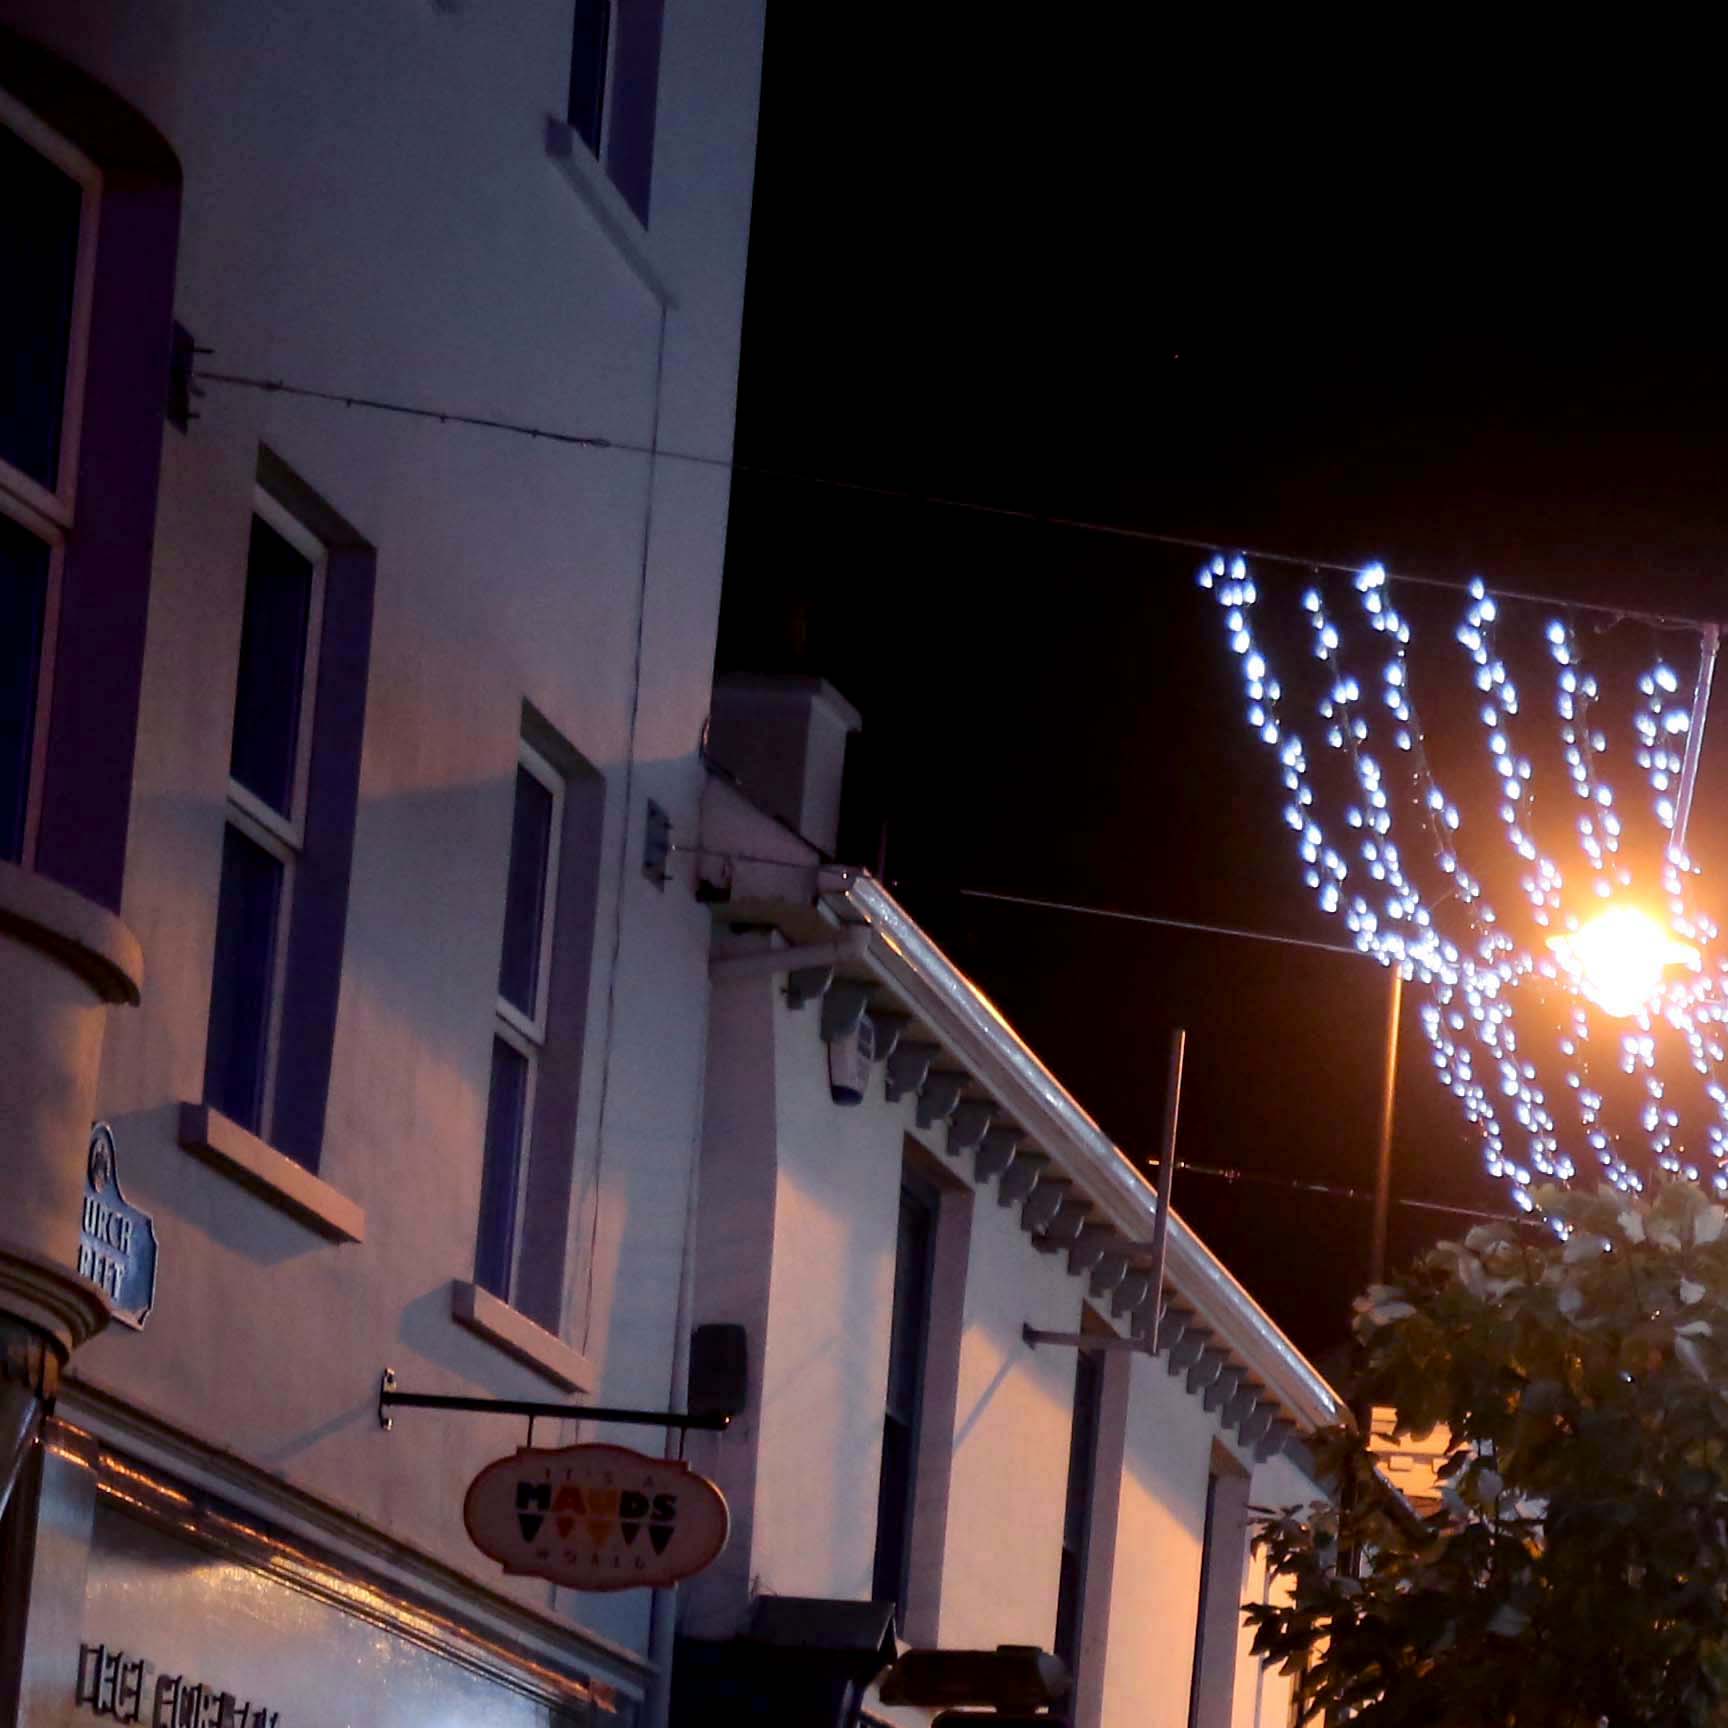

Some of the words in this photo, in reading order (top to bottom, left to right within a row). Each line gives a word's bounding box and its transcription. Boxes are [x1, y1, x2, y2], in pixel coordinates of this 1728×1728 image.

[82, 1196, 132, 1255] URCH
[77, 1243, 126, 1302] REET
[516, 1480, 679, 1522] MAUDS
